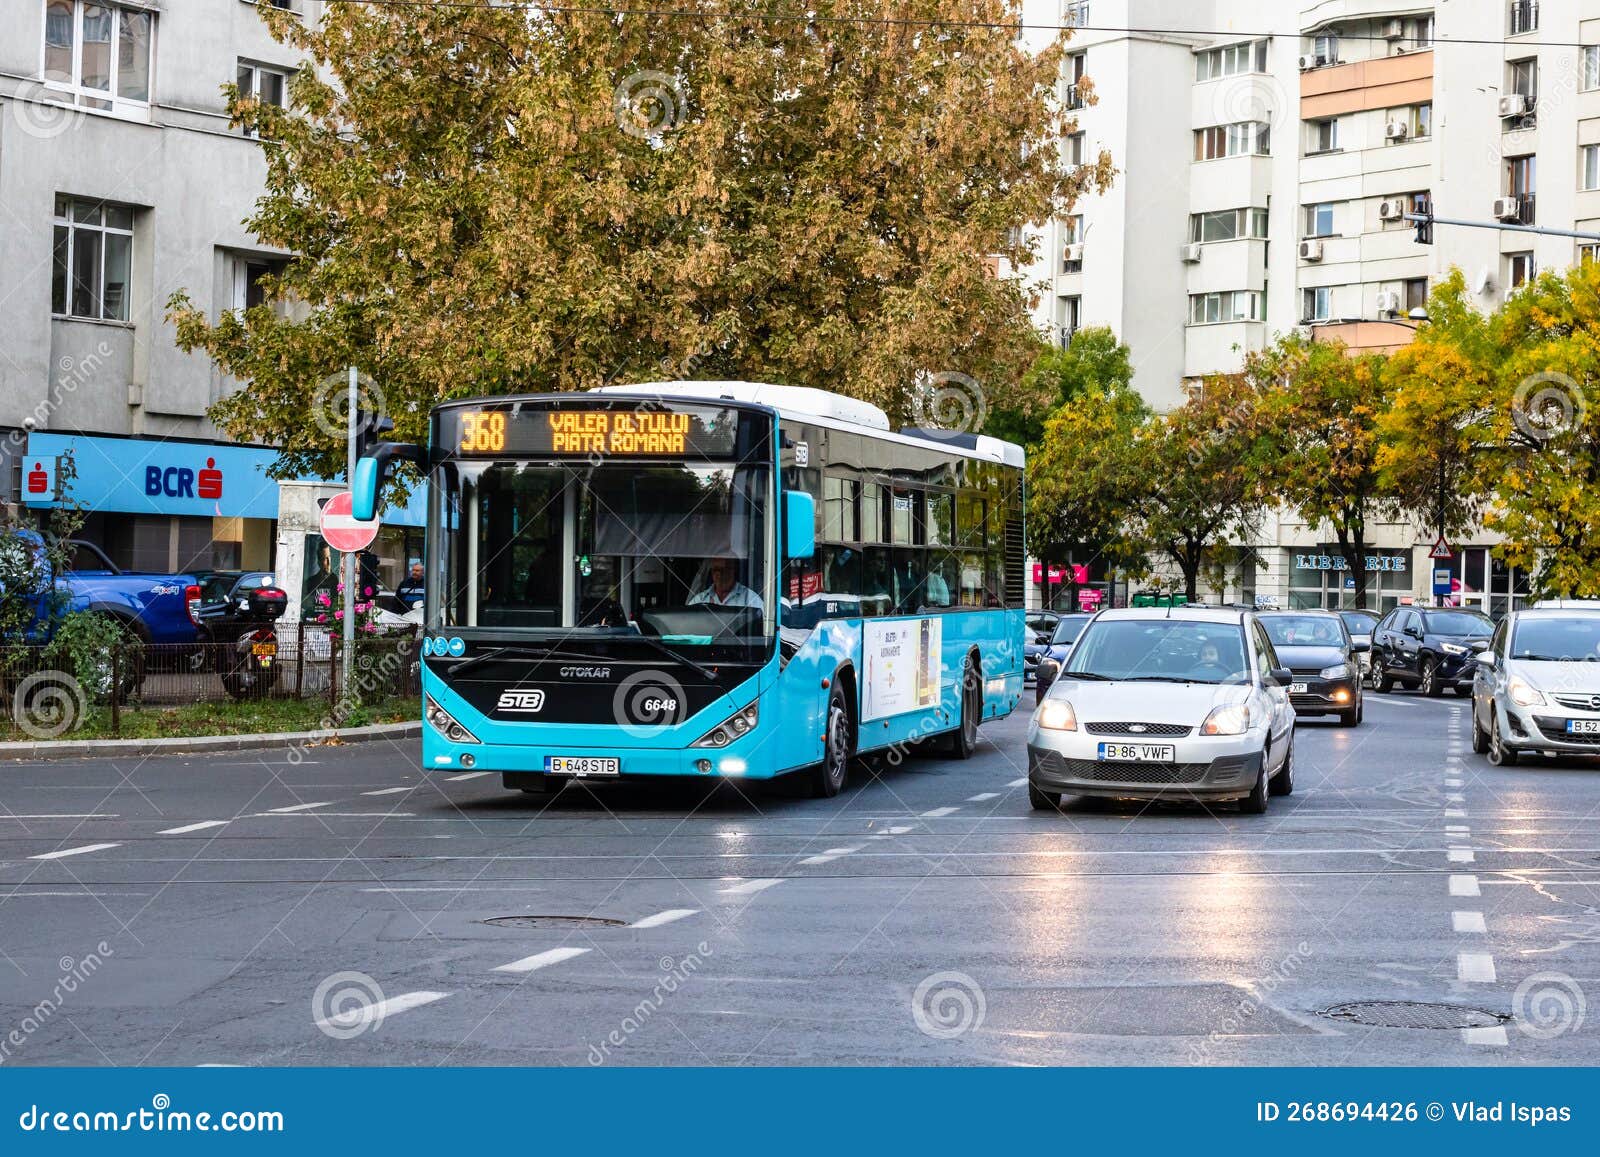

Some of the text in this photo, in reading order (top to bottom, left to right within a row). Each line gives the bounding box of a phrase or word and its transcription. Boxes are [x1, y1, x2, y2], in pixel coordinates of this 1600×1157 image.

[460, 413, 689, 451] 368 VALEA OLTULUI
[552, 433, 685, 452] PIATA ROMANA
[145, 466, 194, 498] BCR
[1296, 555, 1406, 571] LIBRRIE
[560, 667, 611, 678] OTOKAR
[498, 691, 543, 710] STB
[645, 699, 676, 711] 6648
[1575, 721, 1598, 732] B 52
[1107, 746, 1171, 759] B 86 VWF
